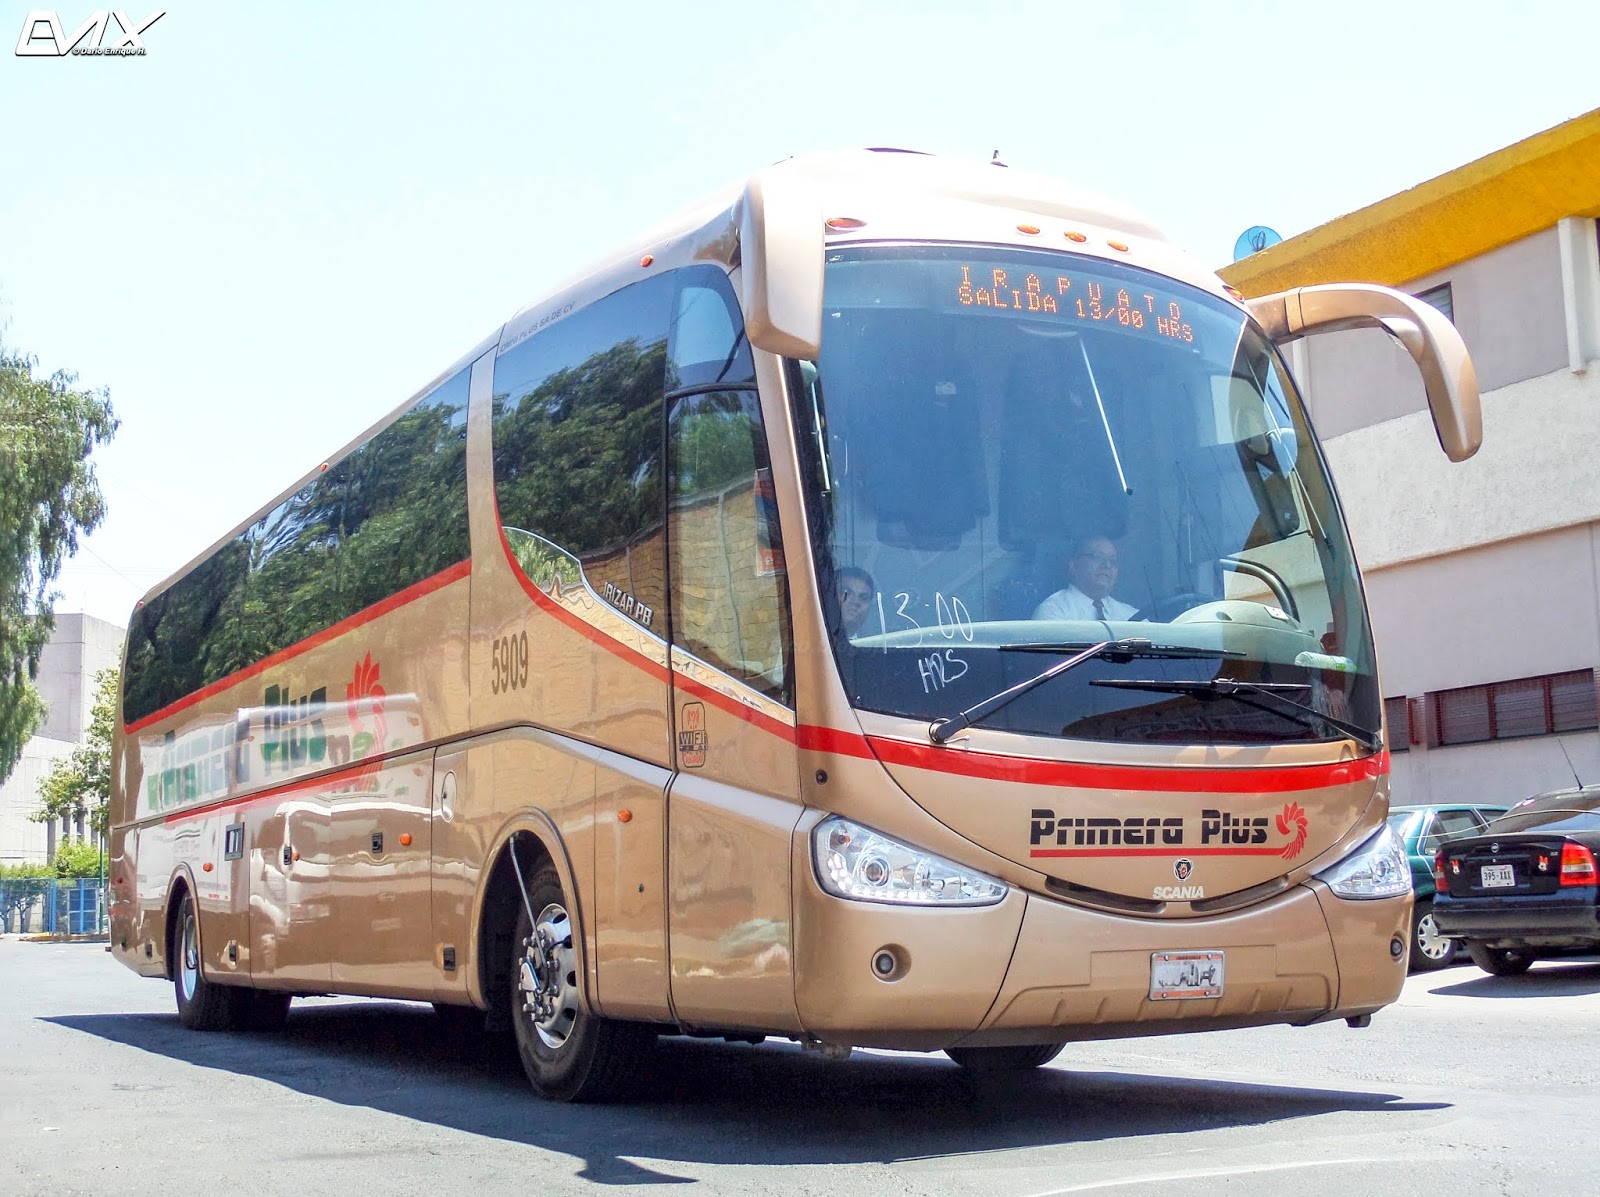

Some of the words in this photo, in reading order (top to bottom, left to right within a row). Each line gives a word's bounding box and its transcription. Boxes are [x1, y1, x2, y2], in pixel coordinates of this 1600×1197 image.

[519, 322, 539, 340] PLUS
[538, 316, 550, 328] SA
[550, 308, 563, 321] DE
[563, 301, 576, 314] CV
[958, 285, 1057, 313] SALIDA
[1076, 298, 1144, 329] 13/00
[1157, 316, 1194, 342] HRS
[602, 581, 636, 615] IRIZAR
[635, 601, 654, 627] PB
[491, 630, 529, 696] 5909
[917, 648, 969, 694] HRS
[1029, 808, 1184, 846] Primera
[1200, 808, 1269, 845] Plus
[1152, 885, 1205, 900] SCANIA
